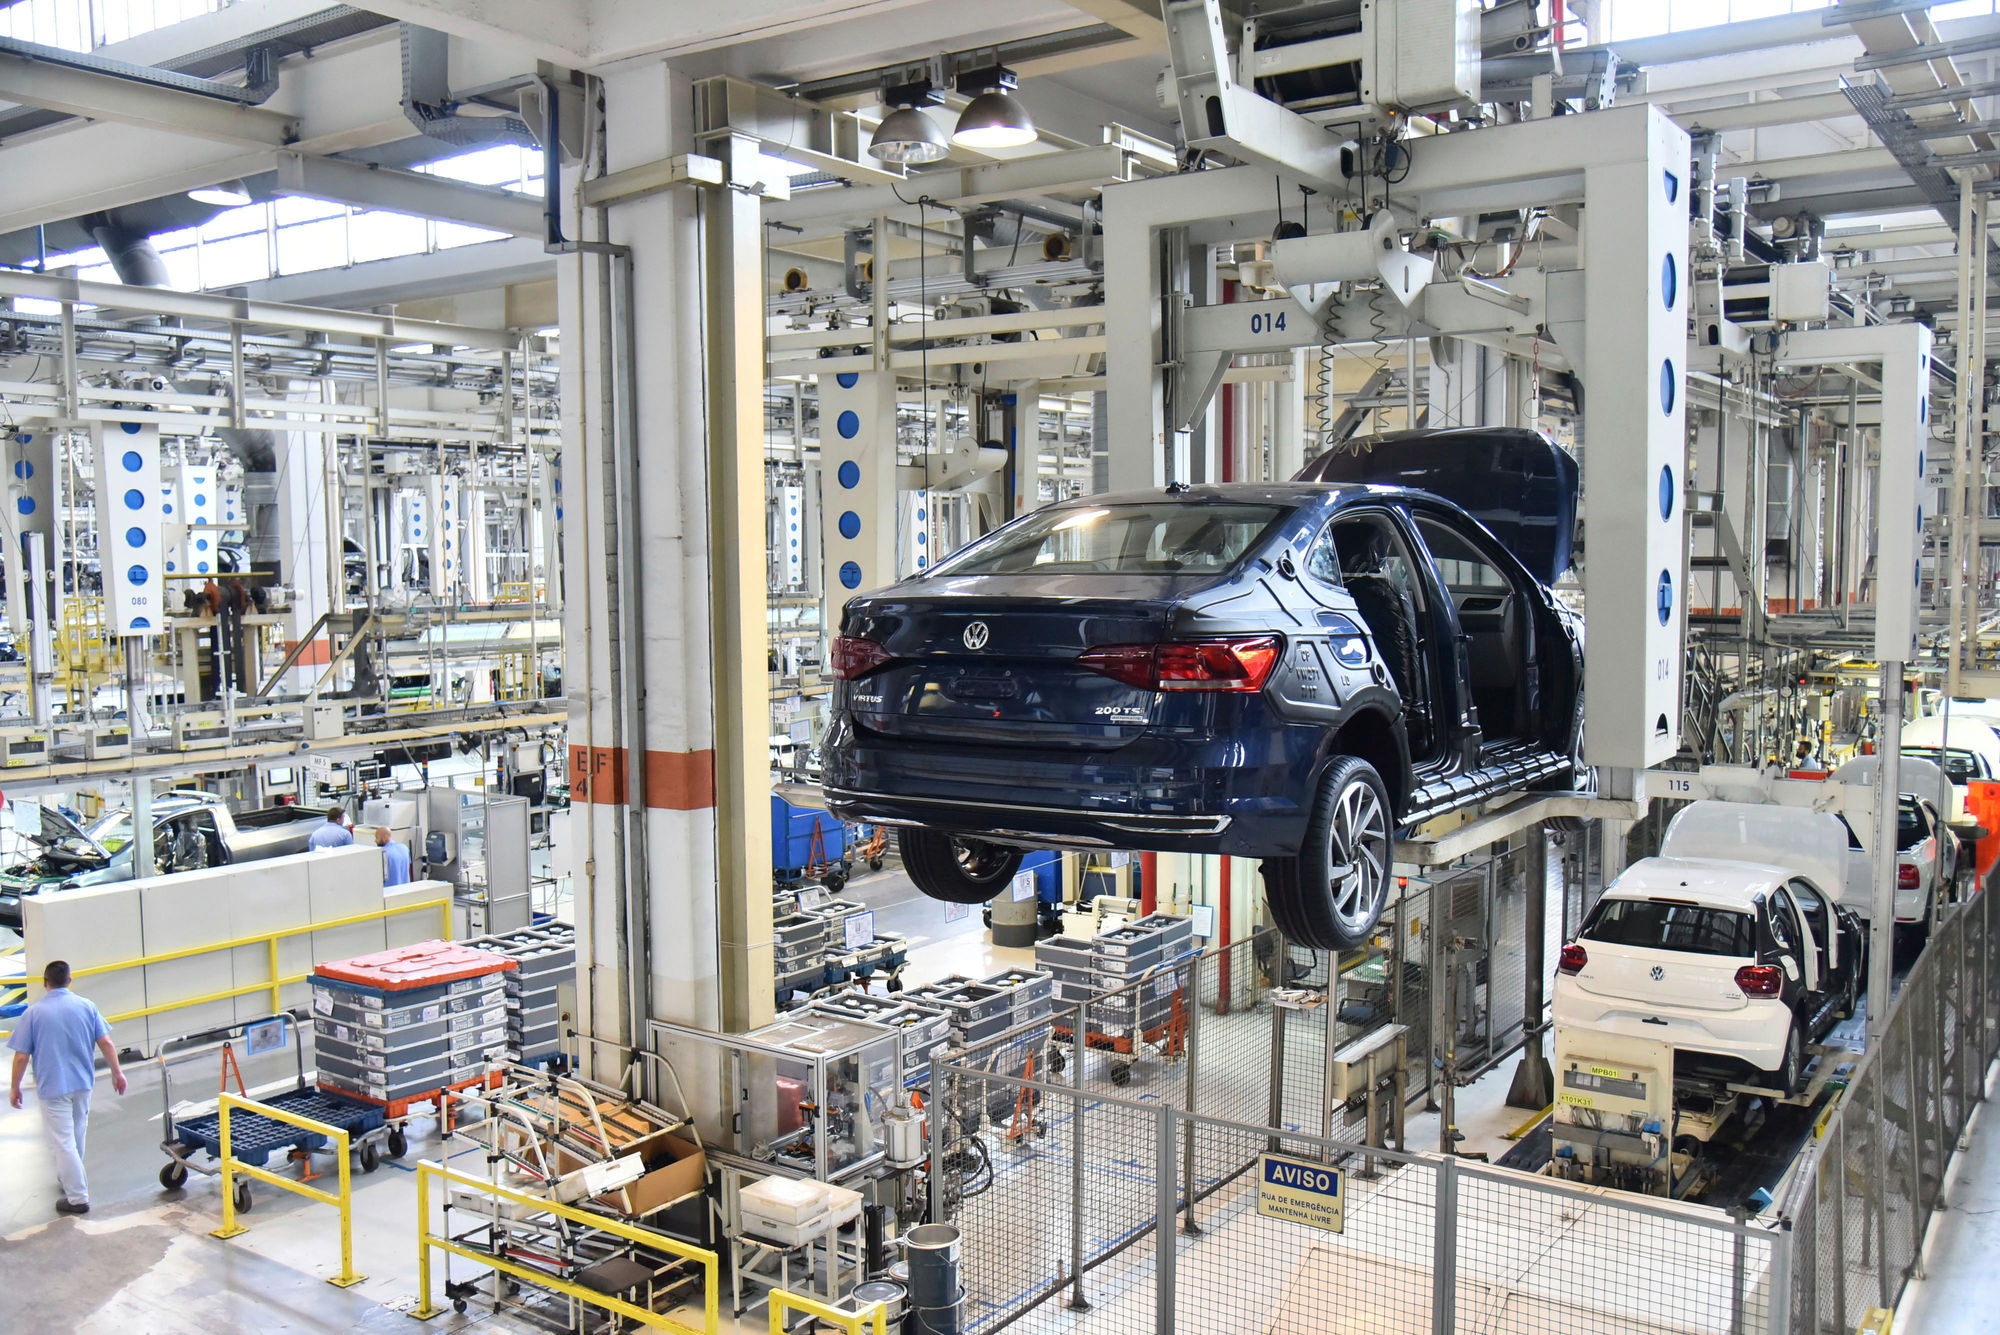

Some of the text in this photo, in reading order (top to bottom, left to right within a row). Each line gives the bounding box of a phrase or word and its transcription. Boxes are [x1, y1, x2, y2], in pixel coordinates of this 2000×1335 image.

[1251, 312, 1286, 334] 014
[131, 597, 147, 606] 080
[1657, 658, 1669, 681] 014
[853, 694, 883, 703] VIRTUS
[1094, 706, 1121, 715] 200
[576, 778, 588, 797] 4
[1669, 780, 1690, 791] 115
[1591, 1067, 1617, 1077] MPB01
[1272, 1165, 1330, 1191] AVISO
[1261, 1192, 1339, 1215] RUA DE EMERGÊNCIA
[1268, 1204, 1331, 1224] MANTENHA LIVRE
